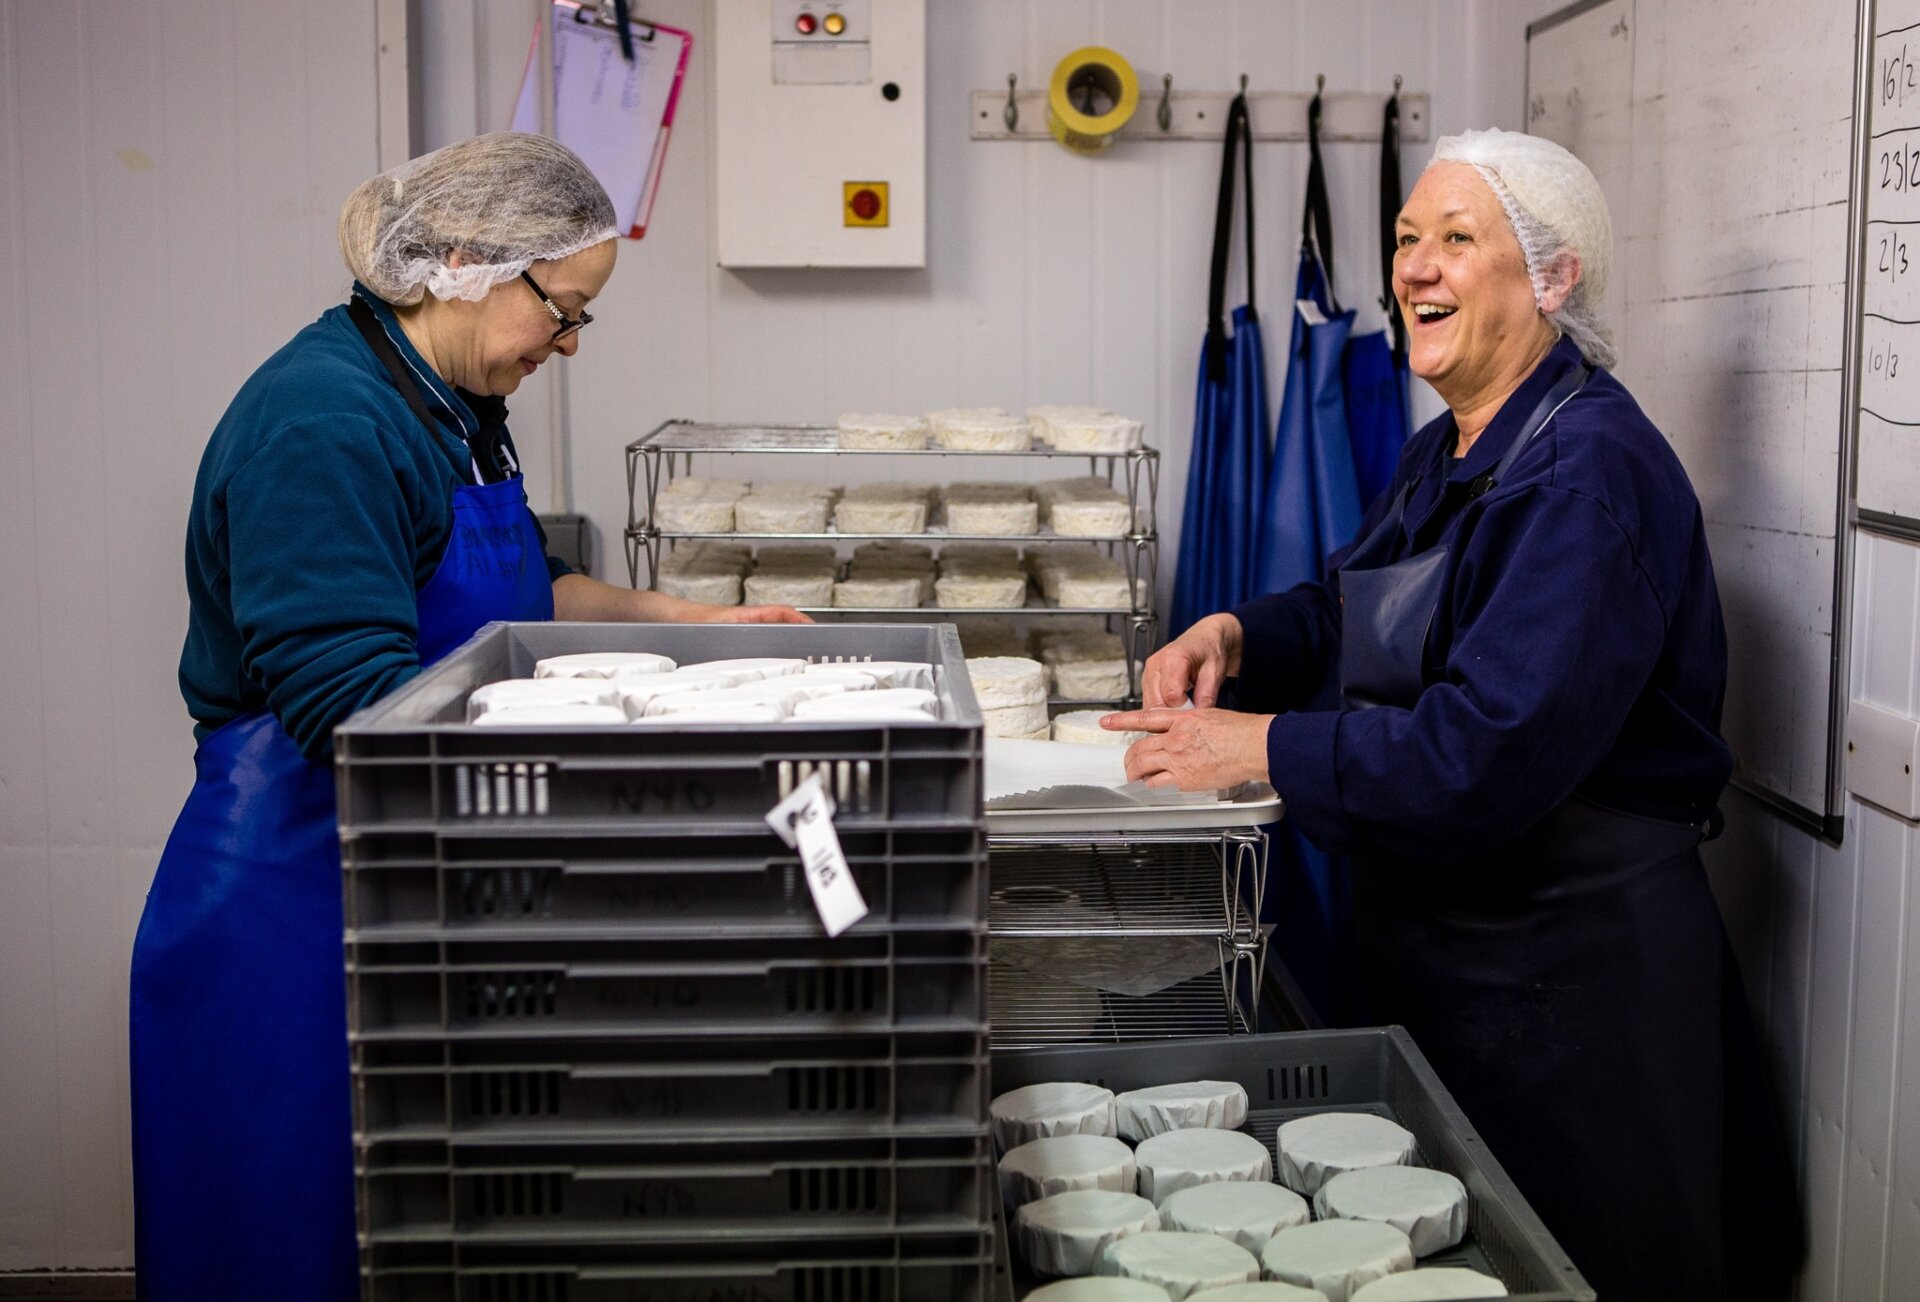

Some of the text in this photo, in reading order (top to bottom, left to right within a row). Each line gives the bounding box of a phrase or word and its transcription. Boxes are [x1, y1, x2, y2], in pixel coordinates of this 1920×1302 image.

[1882, 44, 1917, 107] 16/2
[1880, 142, 1920, 194] 23/2
[1878, 232, 1908, 283] 2/3
[1868, 343, 1899, 382] 10/3
